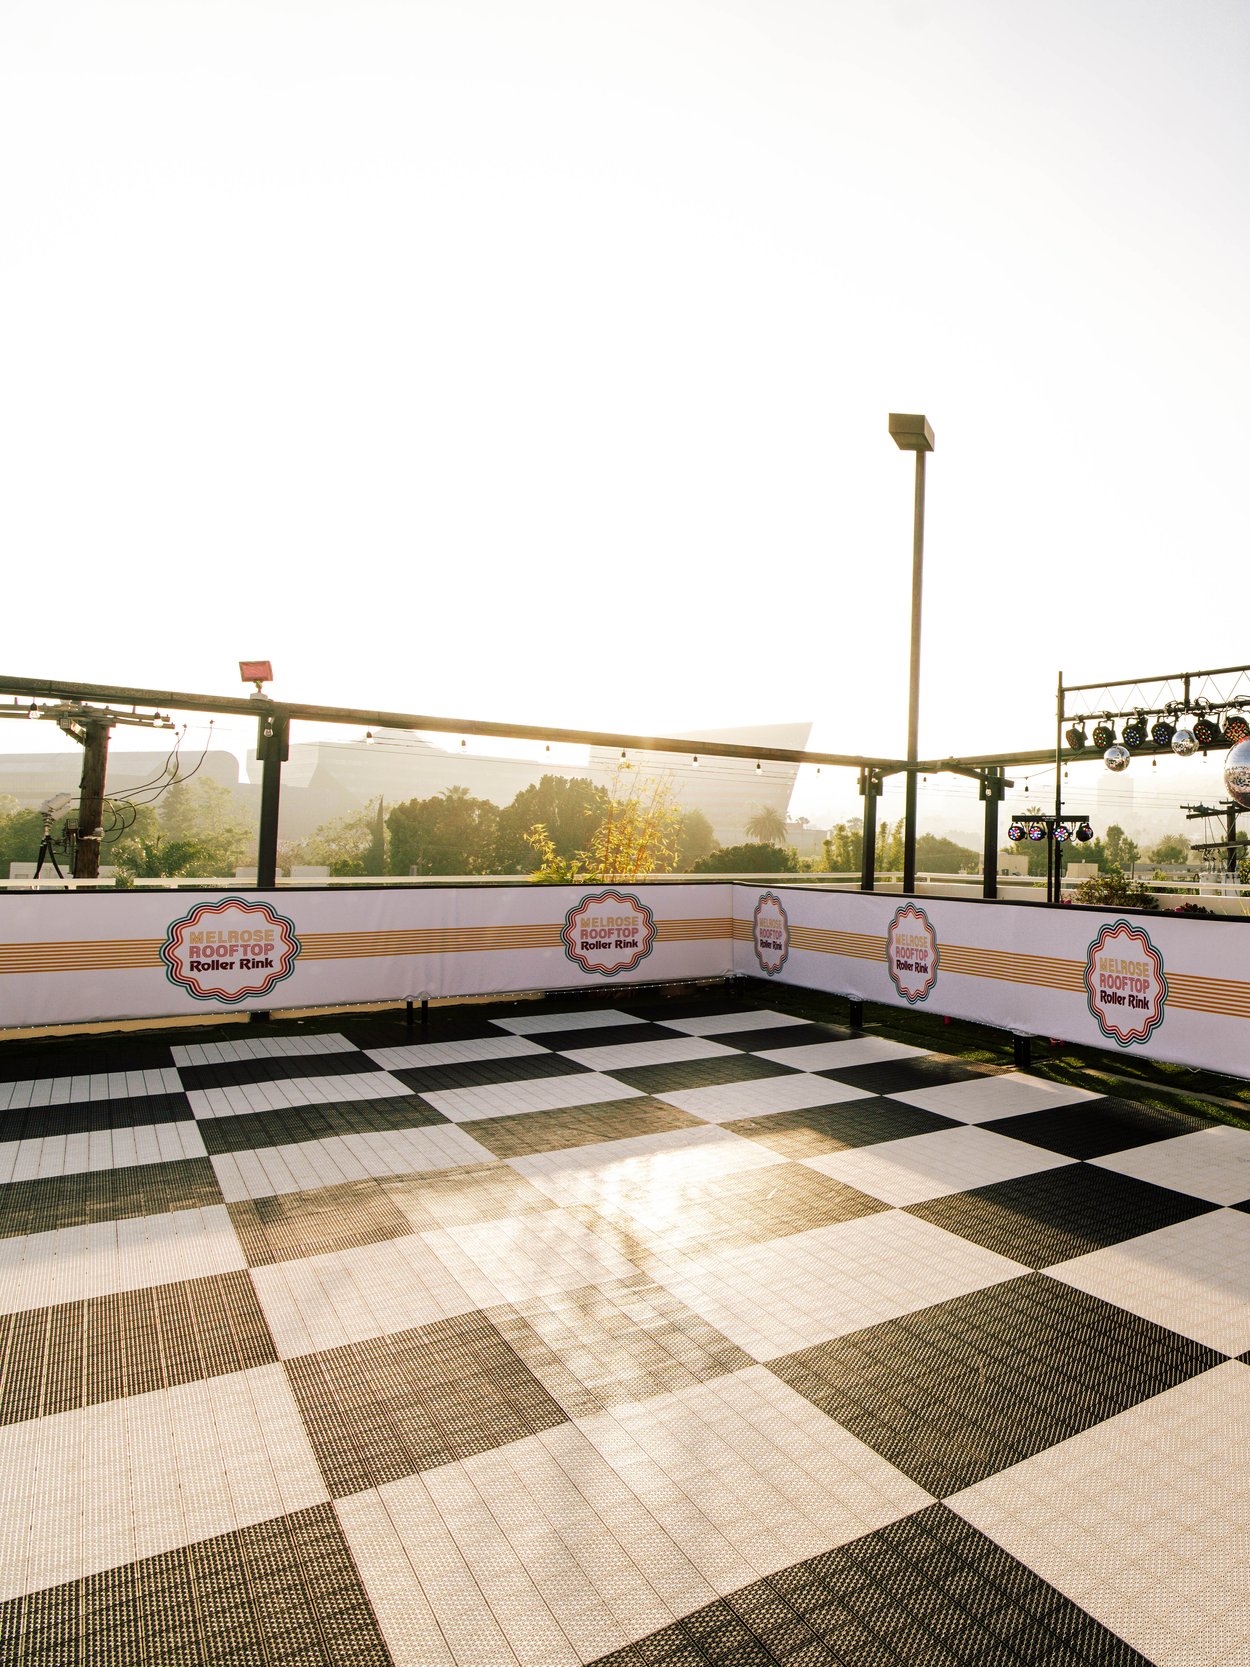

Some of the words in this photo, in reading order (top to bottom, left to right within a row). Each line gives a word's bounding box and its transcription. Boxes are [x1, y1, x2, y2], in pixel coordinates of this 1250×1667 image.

[580, 916, 639, 929] MELROSE
[189, 929, 275, 945] MELROSE
[580, 927, 639, 940] ROOFTOP
[895, 933, 928, 948] MELROSE
[189, 943, 275, 959] ROOFTOP
[580, 941, 612, 951] Roller
[614, 939, 639, 949] Rink
[895, 945, 929, 961] ROOFTOP
[189, 959, 235, 972] Roller
[239, 958, 274, 970] Rink
[896, 959, 914, 971] Roller
[914, 961, 929, 974] Rink
[1099, 957, 1150, 978] MELROSE
[1099, 973, 1150, 994] ROOFTOP
[1100, 990, 1126, 1006] Roller
[1128, 993, 1150, 1010] Rink
